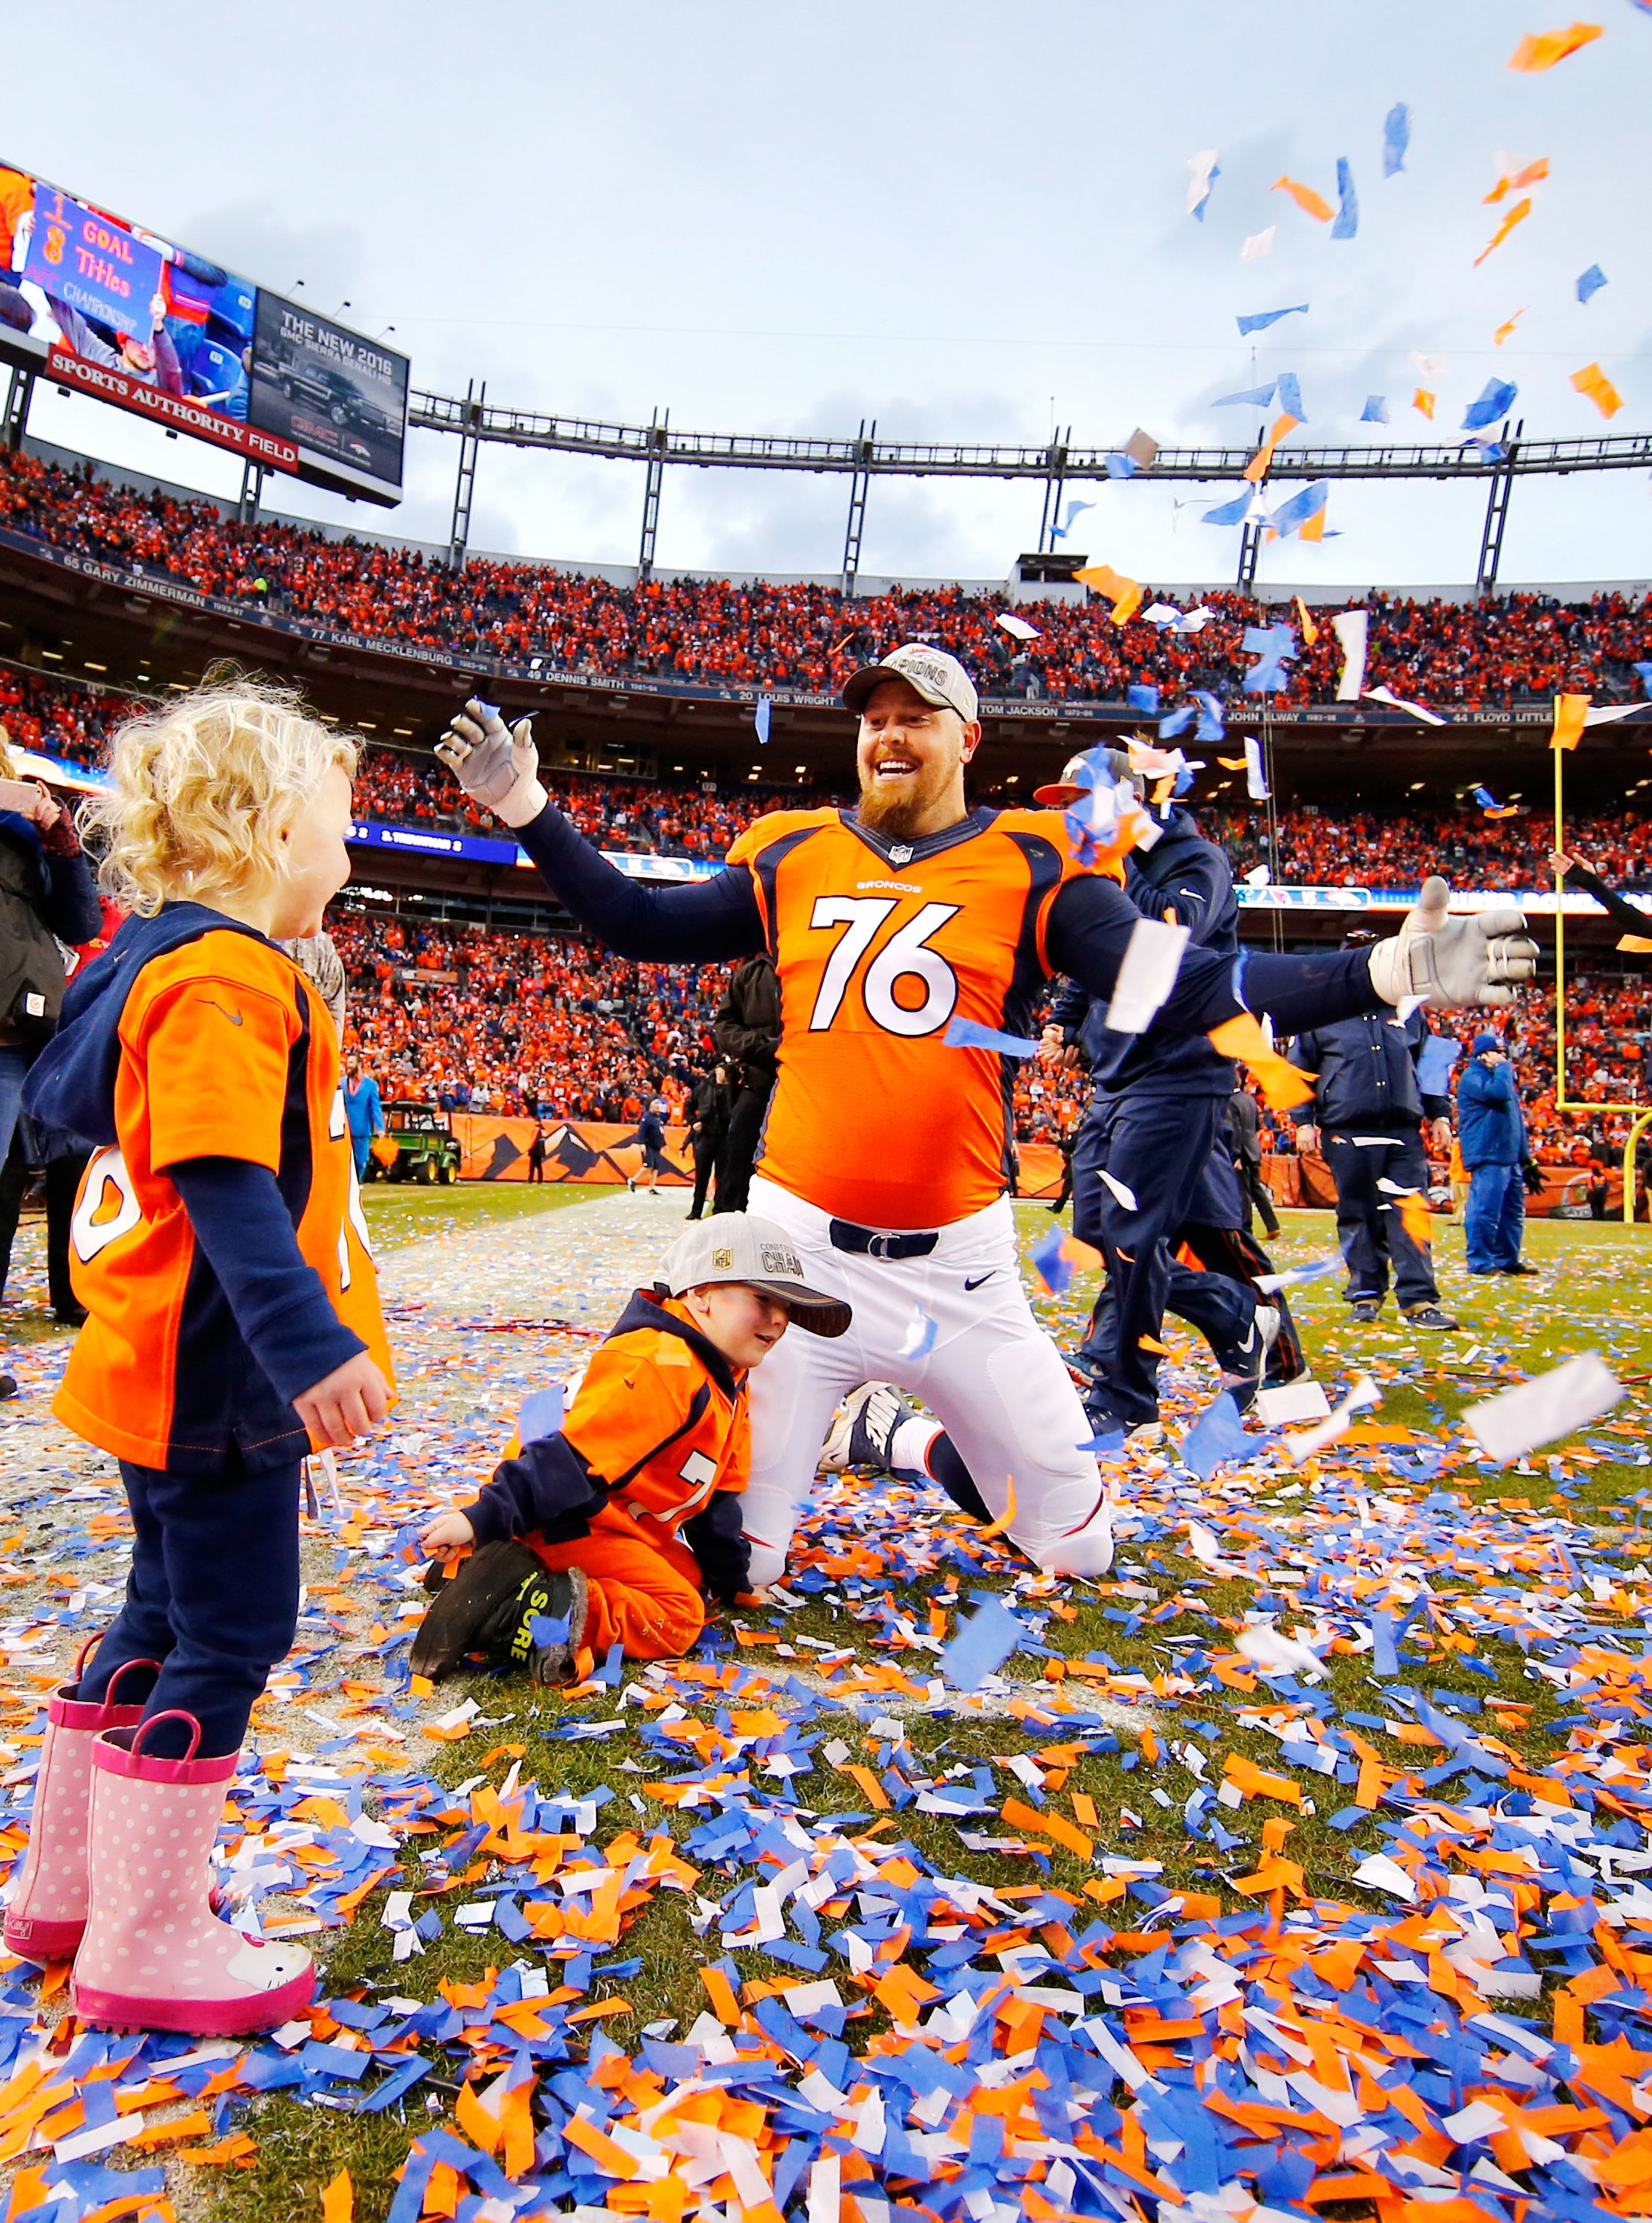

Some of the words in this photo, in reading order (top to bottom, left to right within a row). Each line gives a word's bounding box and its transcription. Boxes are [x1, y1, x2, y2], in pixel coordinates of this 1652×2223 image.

[43, 225, 65, 264] 8
[75, 245, 131, 297] Titles
[83, 221, 135, 264] GOAL
[64, 282, 138, 332] CHAMPIONSHIP
[280, 326, 303, 344] GMC
[304, 339, 341, 363] SIERRA
[343, 358, 376, 380] DENALI
[282, 310, 314, 340] THE
[318, 328, 355, 357] NEW
[358, 347, 393, 376] 2016
[52, 354, 128, 396] SPORTS
[132, 388, 244, 442] AUTHORITY
[248, 433, 295, 462] FIELD
[64, 555, 80, 570] 65
[83, 561, 120, 583] GARY
[124, 574, 206, 607] ZIMMERMAN
[311, 628, 326, 640] 77
[331, 632, 363, 648] KARL
[366, 639, 454, 665] MECKLENBURG
[527, 669, 542, 680] 49
[546, 672, 587, 685] DENNIS
[590, 677, 625, 689] SMITH
[739, 691, 753, 700] 20
[758, 692, 790, 703] LOUIS
[793, 694, 836, 706] WRIGHT
[981, 705, 1004, 715] TOM
[1007, 706, 1059, 717] JACKSON
[1227, 712, 1259, 722] JOHN
[1264, 712, 1300, 722] ELWAY
[1453, 713, 1468, 723] 44
[1474, 712, 1511, 723] FLOYD
[1515, 712, 1554, 723] LITTLE
[856, 880, 922, 894] BRONCOS
[1450, 892, 1515, 906] UPER
[808, 895, 966, 1039] 76
